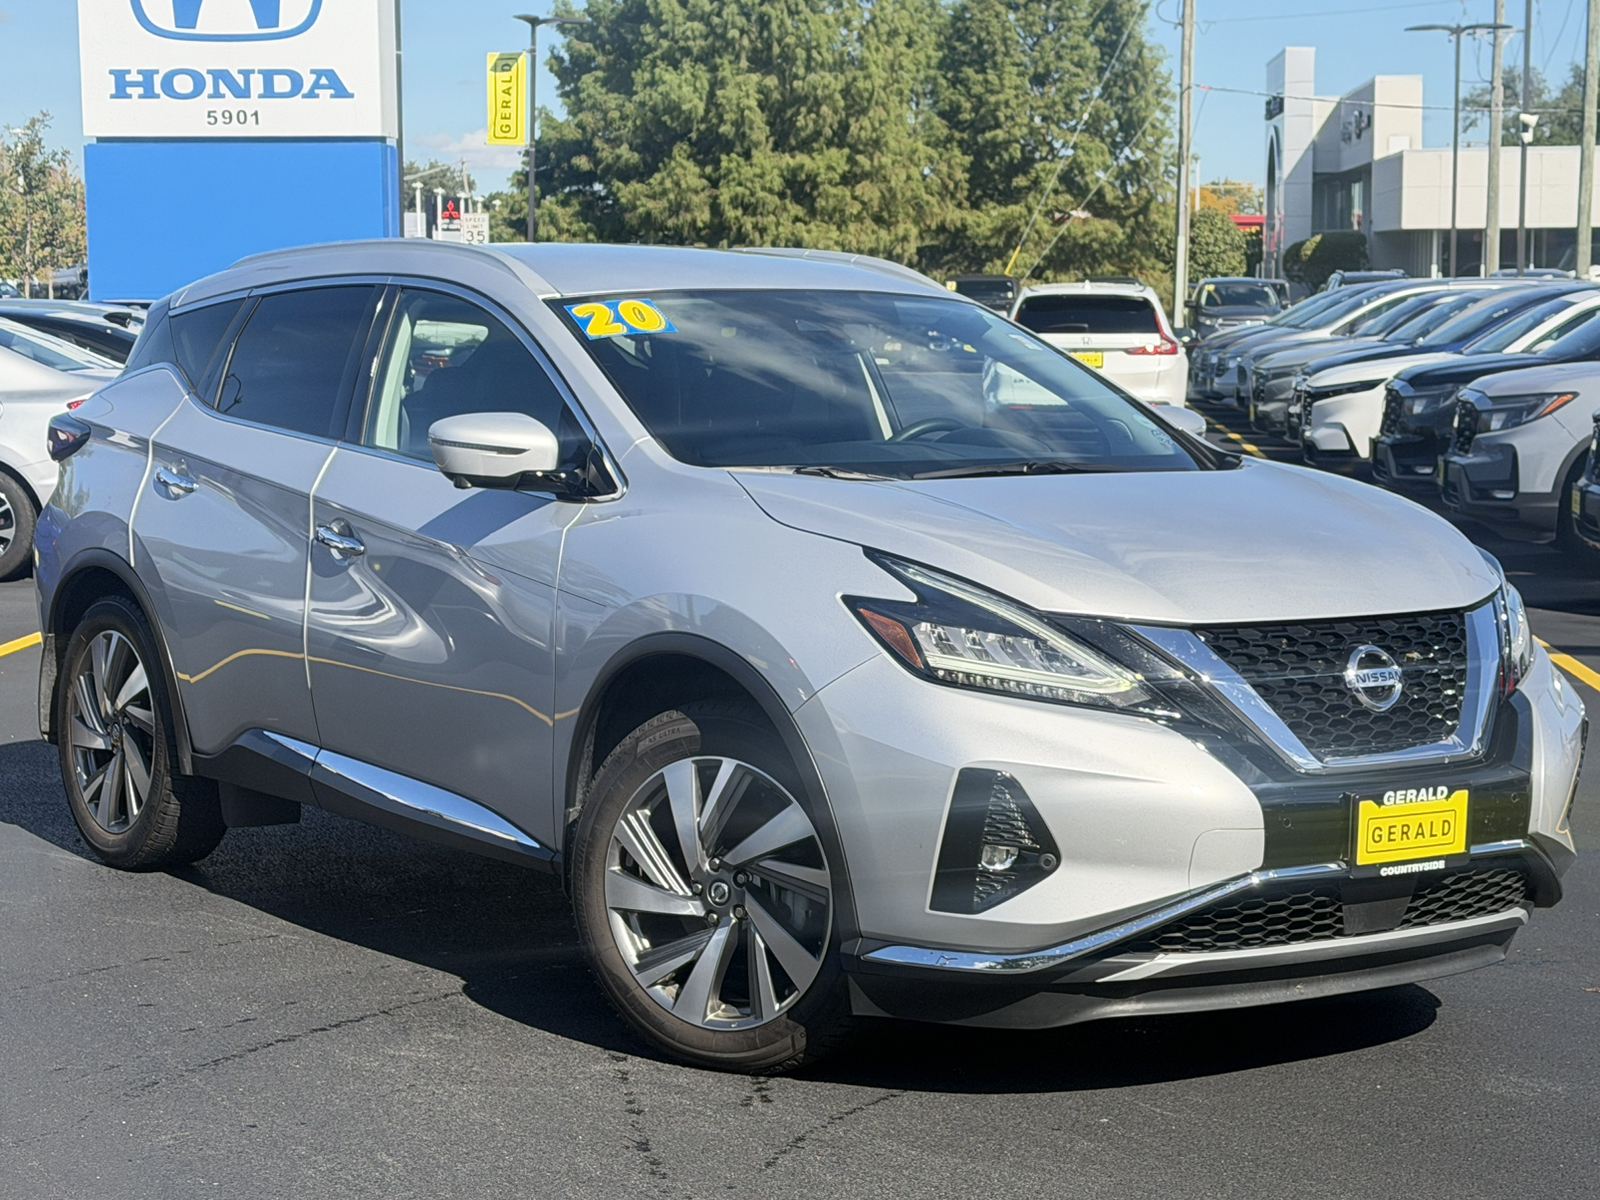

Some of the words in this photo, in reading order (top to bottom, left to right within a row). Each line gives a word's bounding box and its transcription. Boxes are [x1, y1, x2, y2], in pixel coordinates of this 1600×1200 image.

[108, 67, 355, 101] HONDA
[499, 63, 513, 134] GERALD
[206, 109, 261, 126] 5901
[466, 230, 486, 243] 35
[571, 299, 667, 336] 20
[1355, 671, 1401, 684] NISSAN
[658, 727, 681, 738] ULTRA
[1383, 786, 1448, 805] GERALD
[1372, 820, 1451, 843] GERALD
[1380, 860, 1446, 877] COUNTRYSIDE
